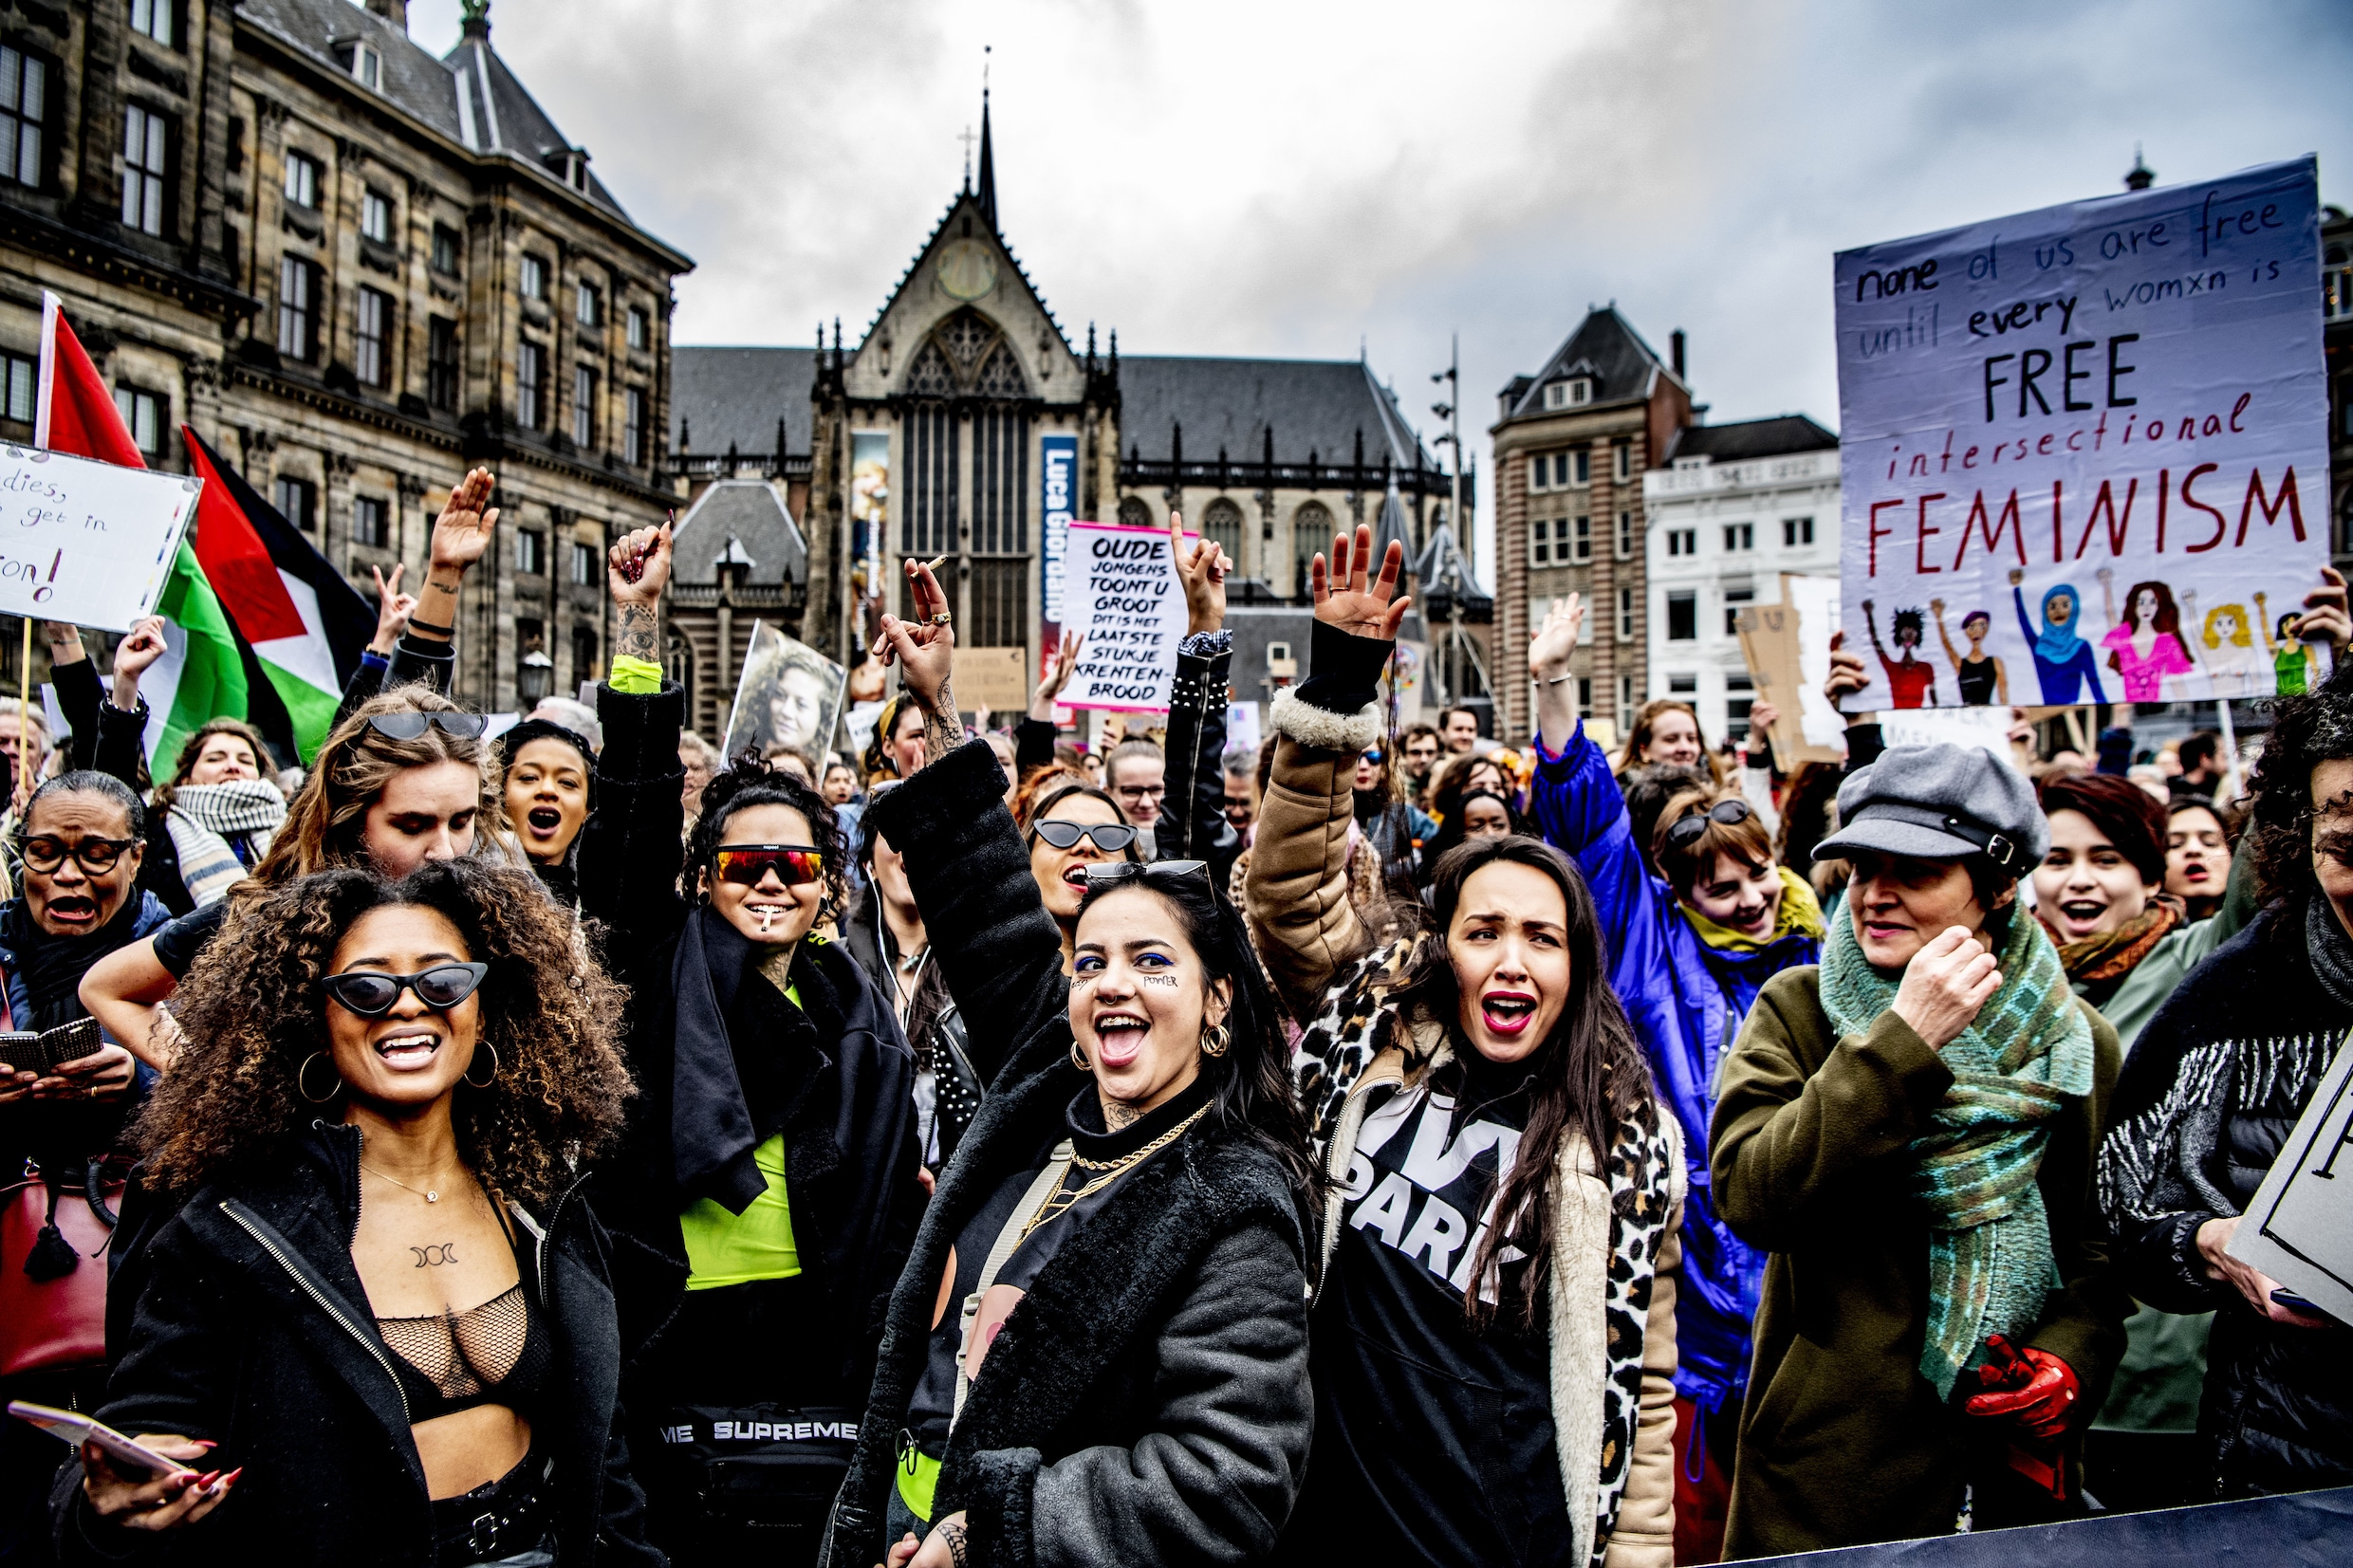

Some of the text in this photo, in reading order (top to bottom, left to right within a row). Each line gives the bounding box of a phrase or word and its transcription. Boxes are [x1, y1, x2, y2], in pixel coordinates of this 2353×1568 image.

[1857, 191, 2285, 303] none of us are free
[1860, 258, 2280, 360] until every womxn is
[1984, 332, 2140, 423] FREE
[1887, 392, 2252, 480] intersectional
[0, 469, 66, 504] dies,
[1046, 449, 1074, 510] Luca
[20, 507, 67, 527] get
[84, 515, 108, 532] in
[1869, 462, 2307, 579] FEMINISM
[1092, 537, 1167, 561] OUDE
[0, 547, 63, 603] on!
[1091, 562, 1167, 577] JONGENS
[1089, 577, 1170, 596] TOONT U
[1095, 596, 1162, 614] GROOT
[1092, 614, 1161, 628] DIT IS HET
[1088, 629, 1163, 646] LAATSTE
[1091, 646, 1160, 663] STUKJE
[1075, 663, 1172, 682] KRENTEN-
[1088, 682, 1157, 700] BROOD
[1143, 975, 1178, 988] POWER
[713, 1421, 859, 1441] SUPREME
